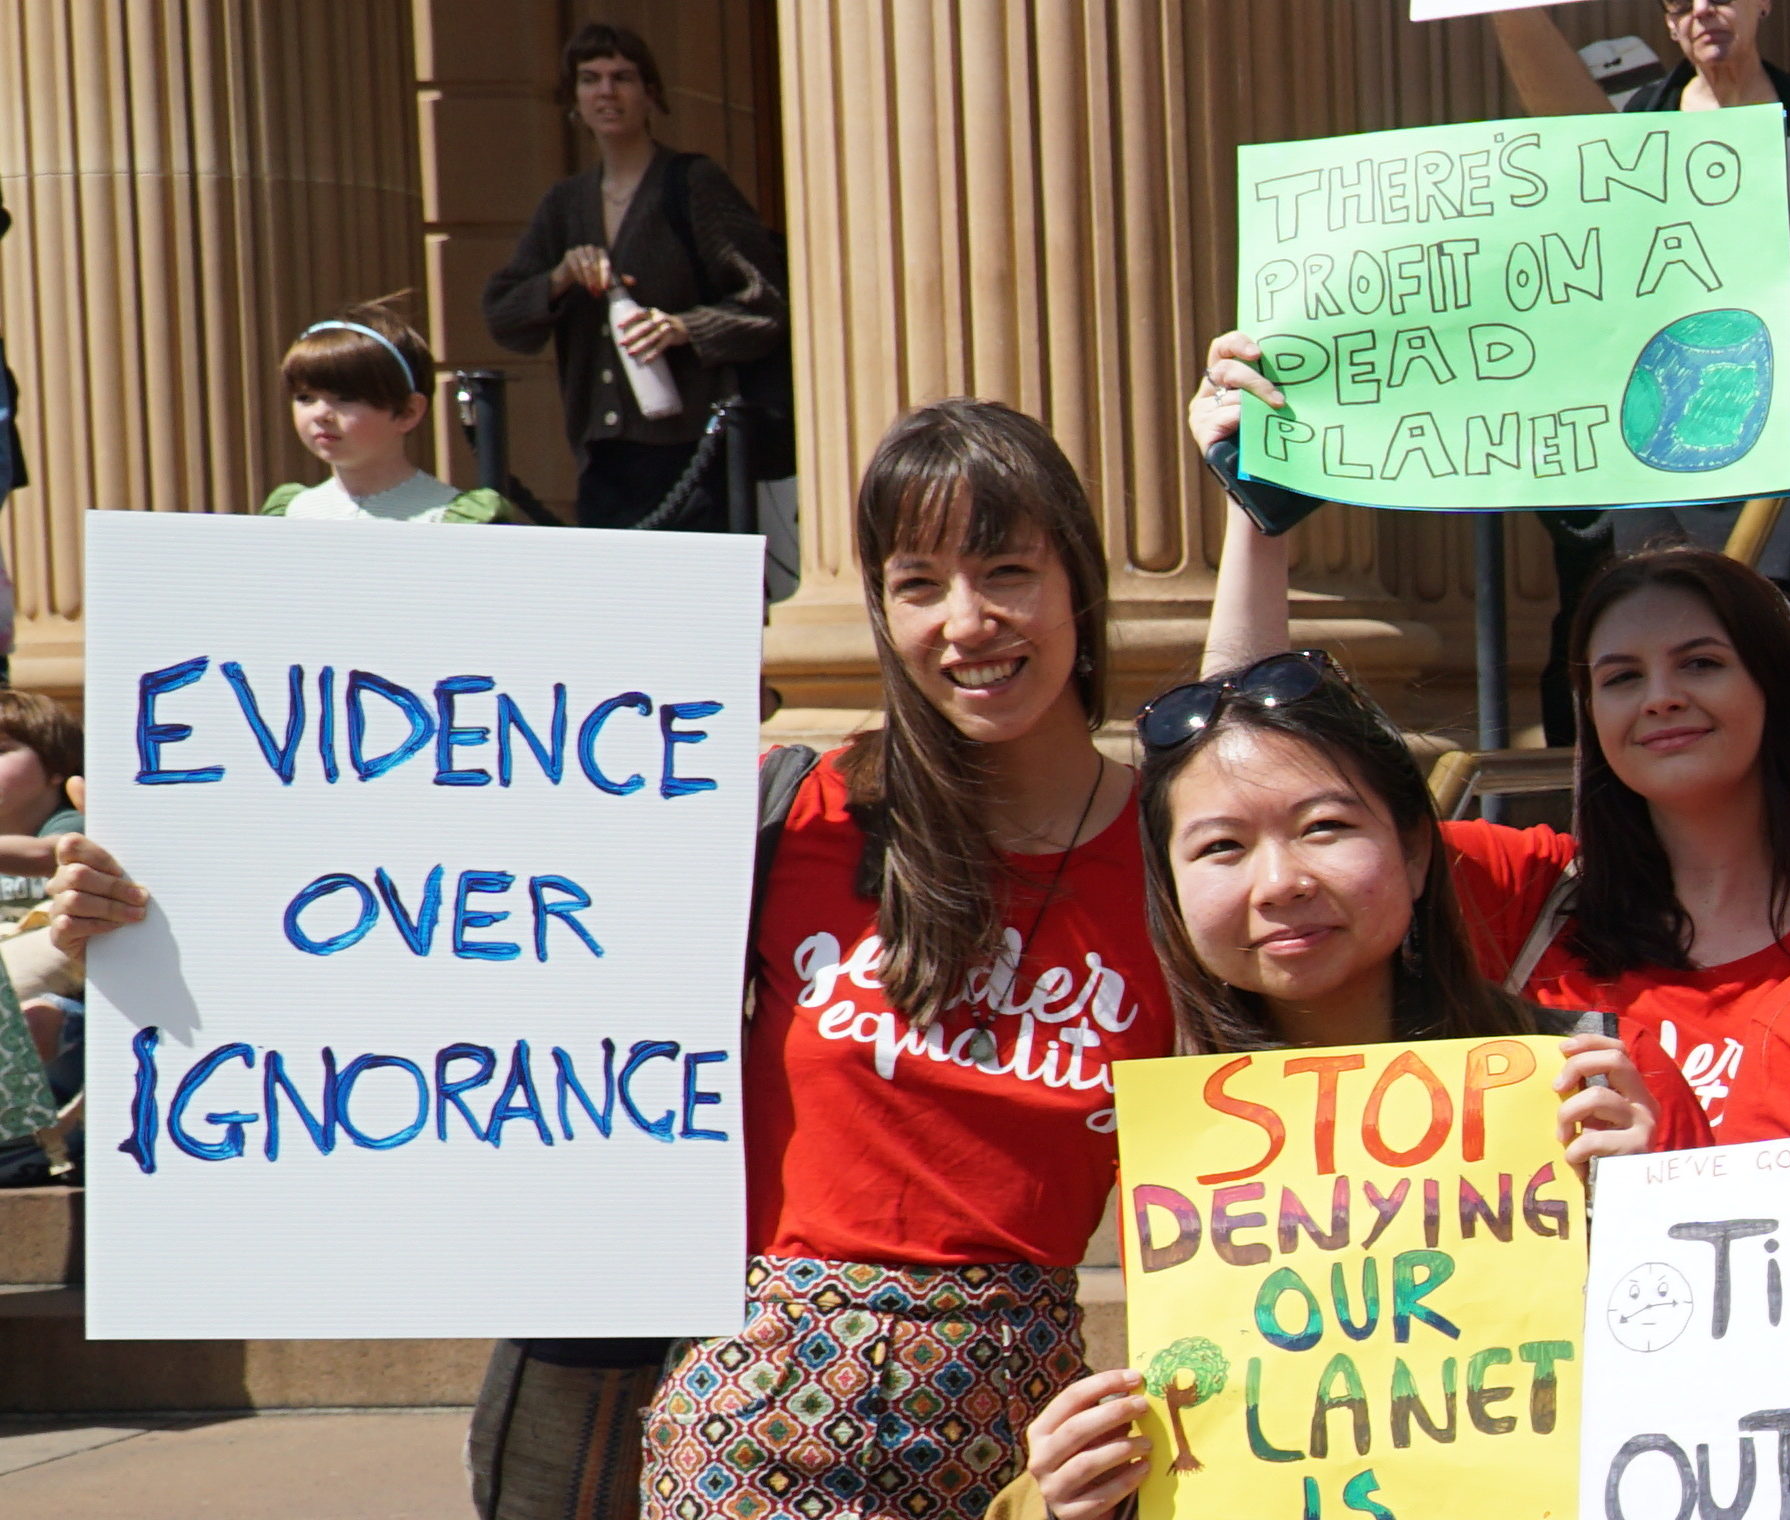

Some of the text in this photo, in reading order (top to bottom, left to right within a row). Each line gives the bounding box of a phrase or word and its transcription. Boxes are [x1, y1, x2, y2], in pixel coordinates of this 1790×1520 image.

[1254, 130, 1741, 243] THERE'S NO
[1255, 222, 1723, 322] PROFIT ON A
[1256, 323, 1537, 406] DEAD
[1263, 405, 1609, 481] PLANET
[136, 655, 725, 799] EVIDENCE
[284, 864, 605, 963] OVER
[793, 926, 1139, 1033] geder
[119, 1026, 729, 1174] IGNORANCE
[1196, 1040, 1537, 1185] STOP
[1132, 1161, 1570, 1274] DENYING
[1645, 1153, 1729, 1186] WE'VE
[1254, 1250, 1461, 1353] OUR
